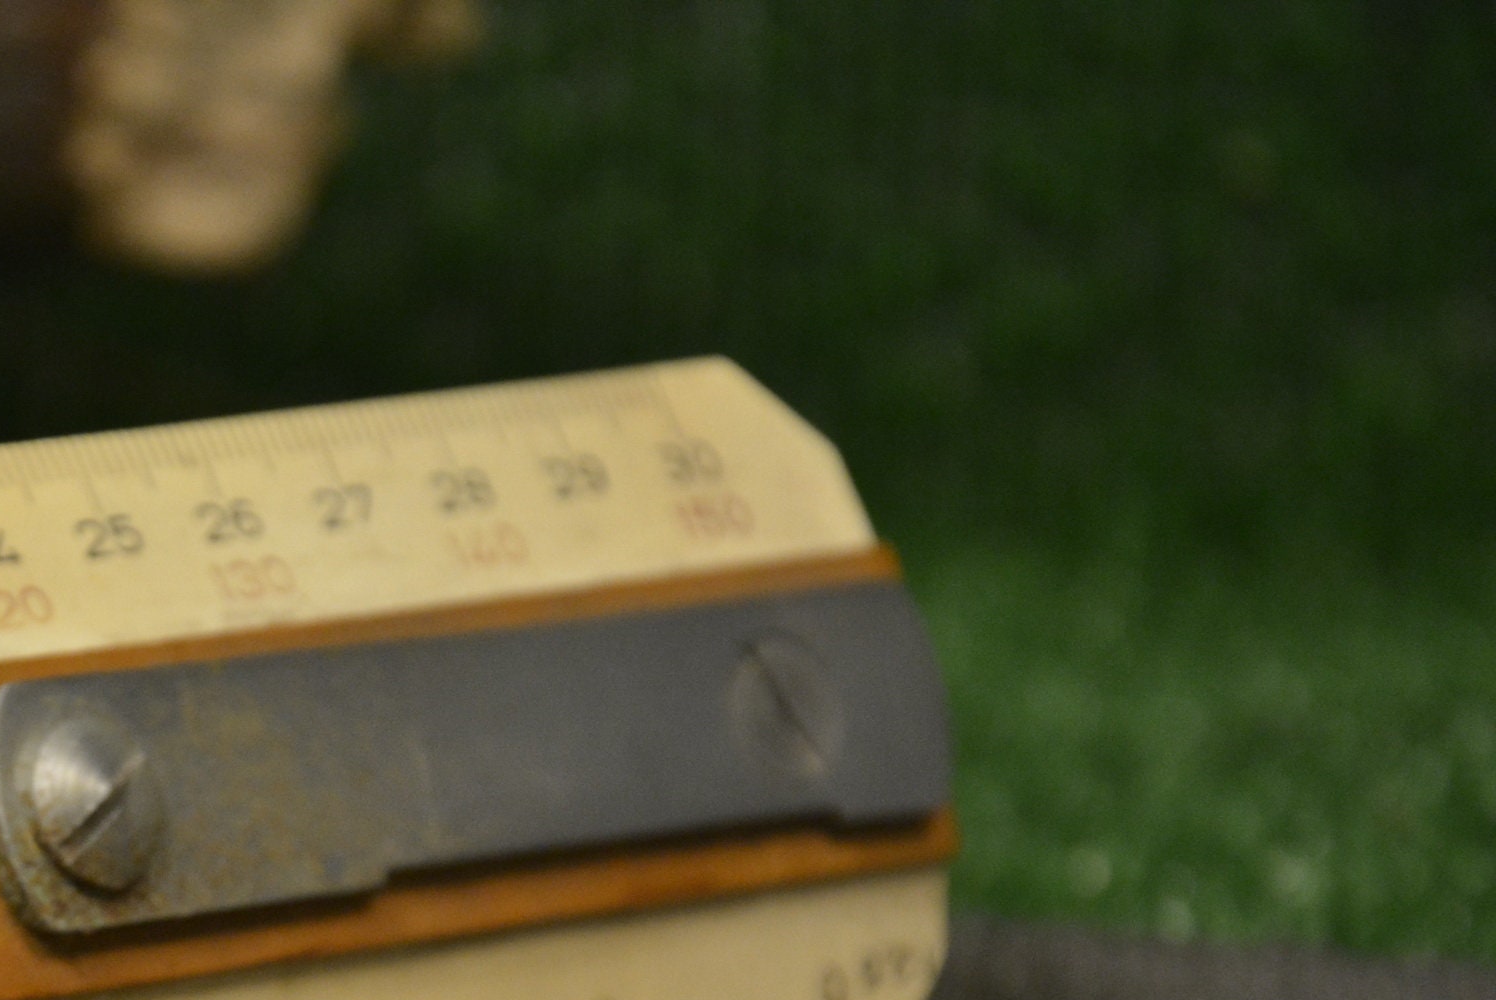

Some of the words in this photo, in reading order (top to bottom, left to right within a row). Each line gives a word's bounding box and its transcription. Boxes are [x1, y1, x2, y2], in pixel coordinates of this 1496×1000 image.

[75, 514, 146, 560] 25
[195, 499, 266, 544] 26
[311, 483, 374, 531] 27
[429, 467, 497, 514] 28
[540, 452, 611, 500] 29
[657, 437, 726, 487] 30
[211, 554, 298, 603] 130
